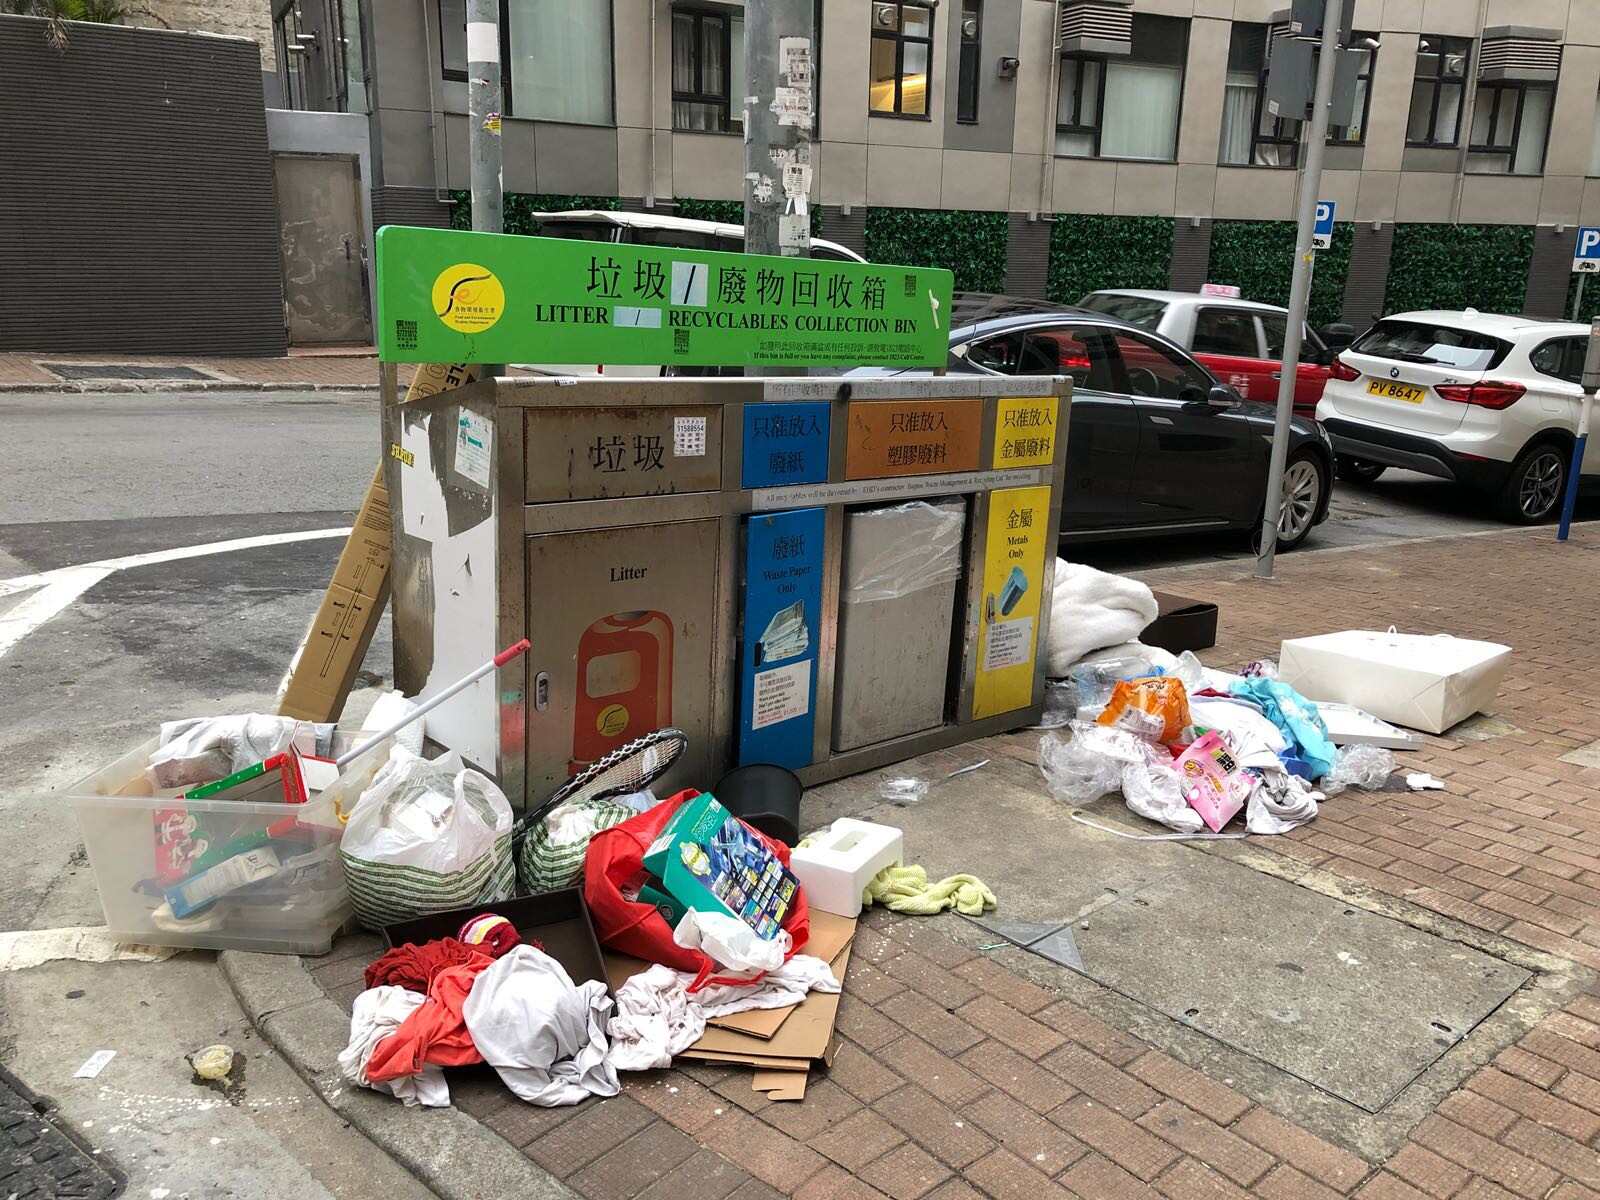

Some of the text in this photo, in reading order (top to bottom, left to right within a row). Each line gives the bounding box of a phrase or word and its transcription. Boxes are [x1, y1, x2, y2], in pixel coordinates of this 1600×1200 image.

[1580, 230, 1600, 256] P
[535, 303, 609, 326] LITTER
[669, 310, 789, 331] RECYCLABLES
[795, 315, 888, 334] COLLECTION
[894, 318, 917, 334] BIN
[1369, 381, 1423, 401] PV 8647
[752, 413, 822, 440] 只准放入
[889, 411, 949, 434] 只准放入
[1003, 406, 1053, 429] 只准放入
[591, 434, 665, 474] 垃圾
[1000, 436, 1051, 460] 金屬廢料
[1006, 507, 1033, 530] 金屬
[1006, 535, 1029, 547] Metals
[1008, 548, 1025, 560] Only
[610, 566, 648, 583] Litter
[764, 564, 812, 581] Waste Paper
